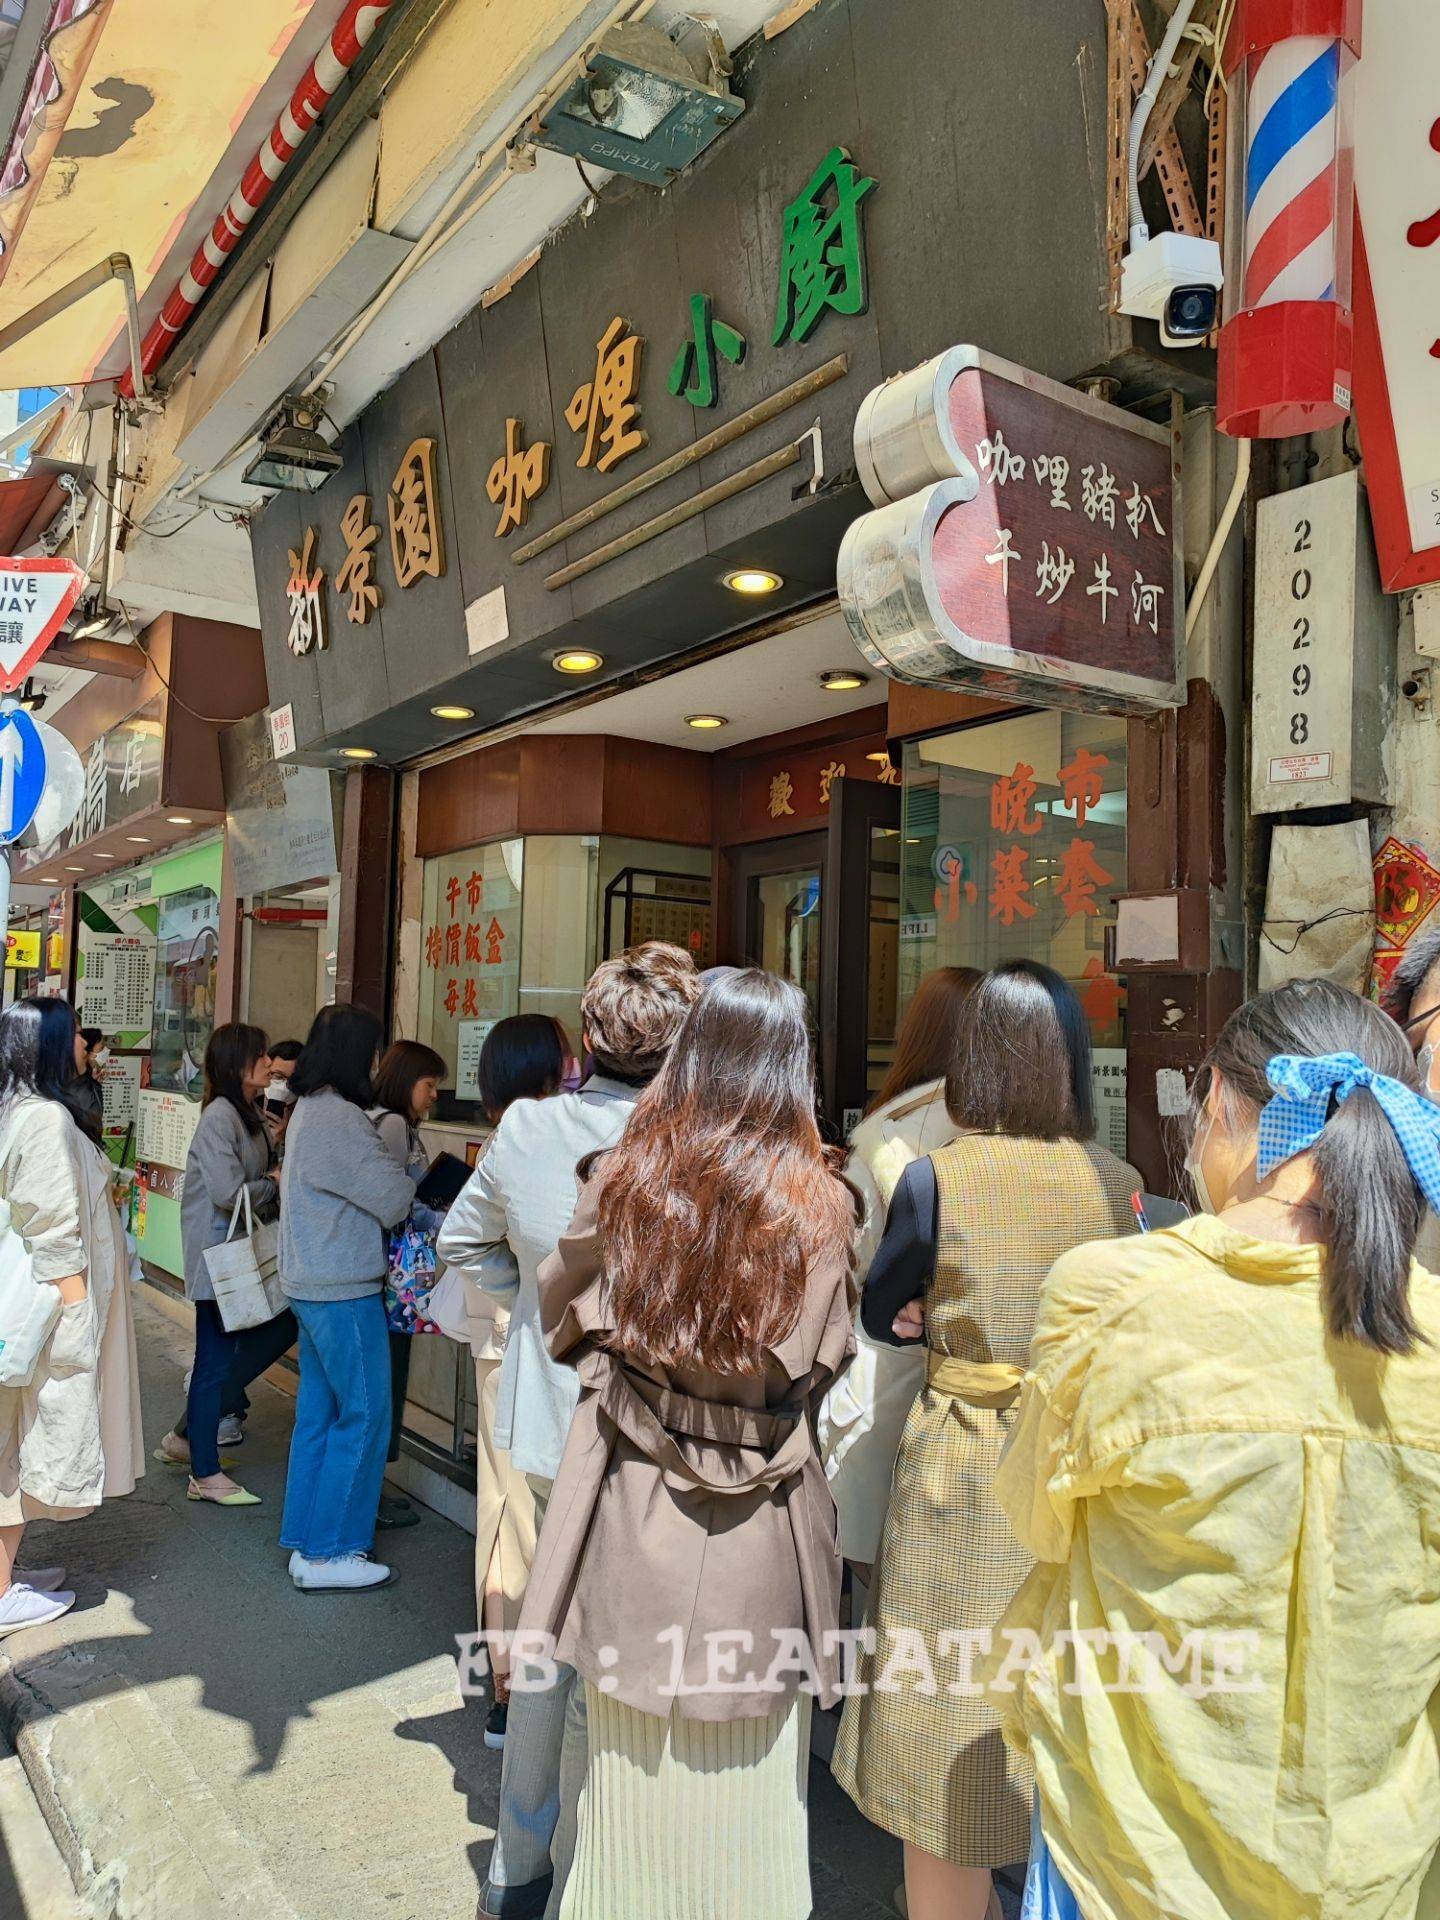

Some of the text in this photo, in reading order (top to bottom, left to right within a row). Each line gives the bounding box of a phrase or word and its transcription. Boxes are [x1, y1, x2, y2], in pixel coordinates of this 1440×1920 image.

[975, 429, 1167, 540] 咖哩豬扒
[0, 577, 37, 593] IVE
[1289, 519, 1312, 745] 20298
[991, 748, 1110, 835] 晚市
[446, 870, 483, 919] 午市
[425, 916, 505, 970] 特價飯盒
